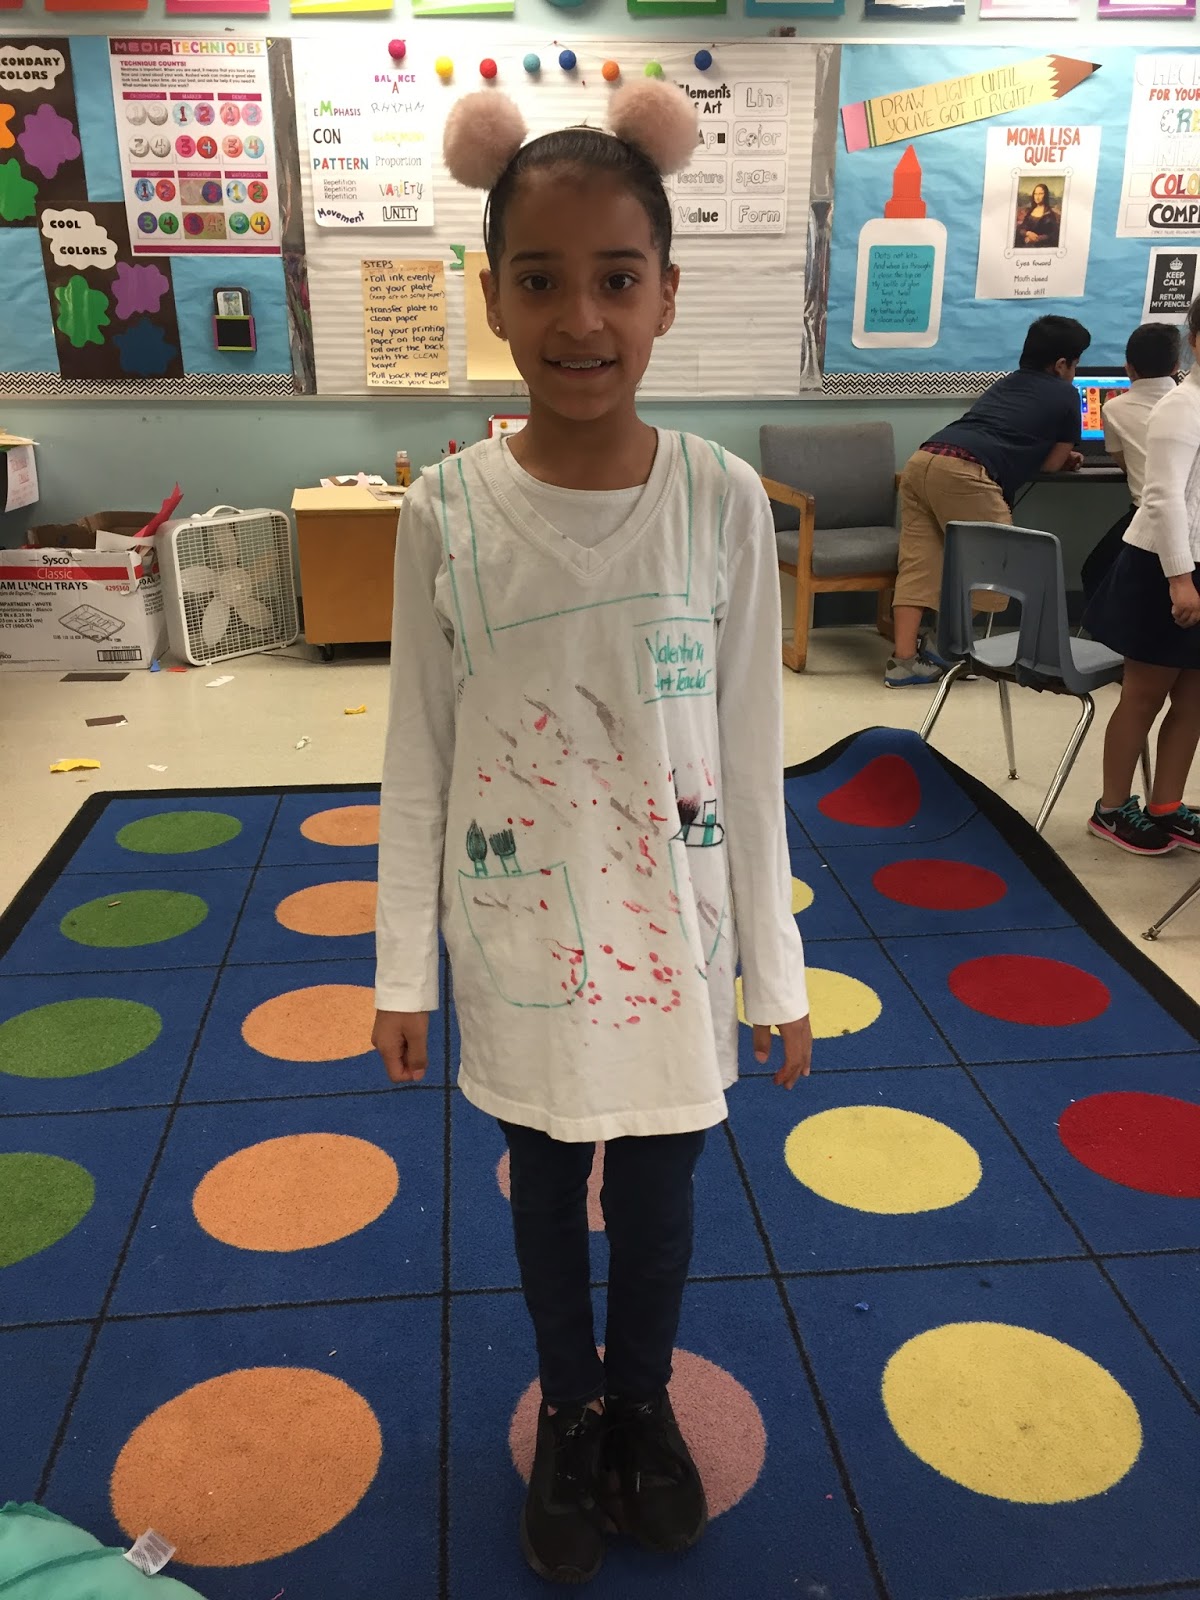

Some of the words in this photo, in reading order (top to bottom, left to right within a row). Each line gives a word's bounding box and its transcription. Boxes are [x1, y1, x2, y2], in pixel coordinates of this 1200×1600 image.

[114, 42, 171, 52] MEDIA
[173, 42, 260, 56] TECHNIQUES
[0, 71, 48, 79] COLORS
[679, 83, 731, 98] lements
[880, 90, 924, 118] DRAW
[935, 77, 975, 106] LIGHT
[982, 67, 1021, 94] UNTIL
[1149, 88, 1170, 101] FOR
[1175, 88, 1200, 101] YOUR
[371, 102, 425, 113] RHYTHM
[703, 100, 722, 114] Art
[940, 102, 966, 124] GOT
[974, 98, 984, 116] IT
[989, 85, 1034, 113] RIGHT!
[313, 128, 341, 144] CON
[736, 124, 781, 148] Color
[1007, 127, 1045, 146] MONA
[1050, 127, 1080, 146] LISA
[375, 156, 422, 167] Proportion
[1024, 146, 1067, 166] QUIET
[313, 158, 369, 170] PATTERN
[1151, 173, 1200, 199] COLO
[324, 192, 358, 200] Repetition
[317, 208, 364, 223] Movement
[383, 206, 418, 220] UNITY
[678, 206, 718, 223] Value
[738, 206, 780, 223] Form
[1148, 203, 1200, 228] COMP
[50, 220, 81, 228] COOL
[60, 246, 107, 255] COLORS
[364, 260, 393, 269] STEPS
[370, 274, 386, 282] roll
[407, 274, 435, 283] evenly
[386, 285, 406, 294] your
[411, 283, 433, 292] plate
[370, 305, 402, 313] transfer
[407, 305, 426, 313] plate
[396, 315, 418, 323] paper
[370, 327, 384, 337] lay
[389, 328, 409, 337] your
[412, 325, 445, 336] printing
[370, 338, 394, 346] paper
[412, 335, 426, 343] top
[430, 371, 447, 379] paper
[42, 555, 70, 566] Sysco
[37, 568, 73, 580] Classic
[0, 582, 15, 590] AM
[54, 582, 88, 590] TRAYS
